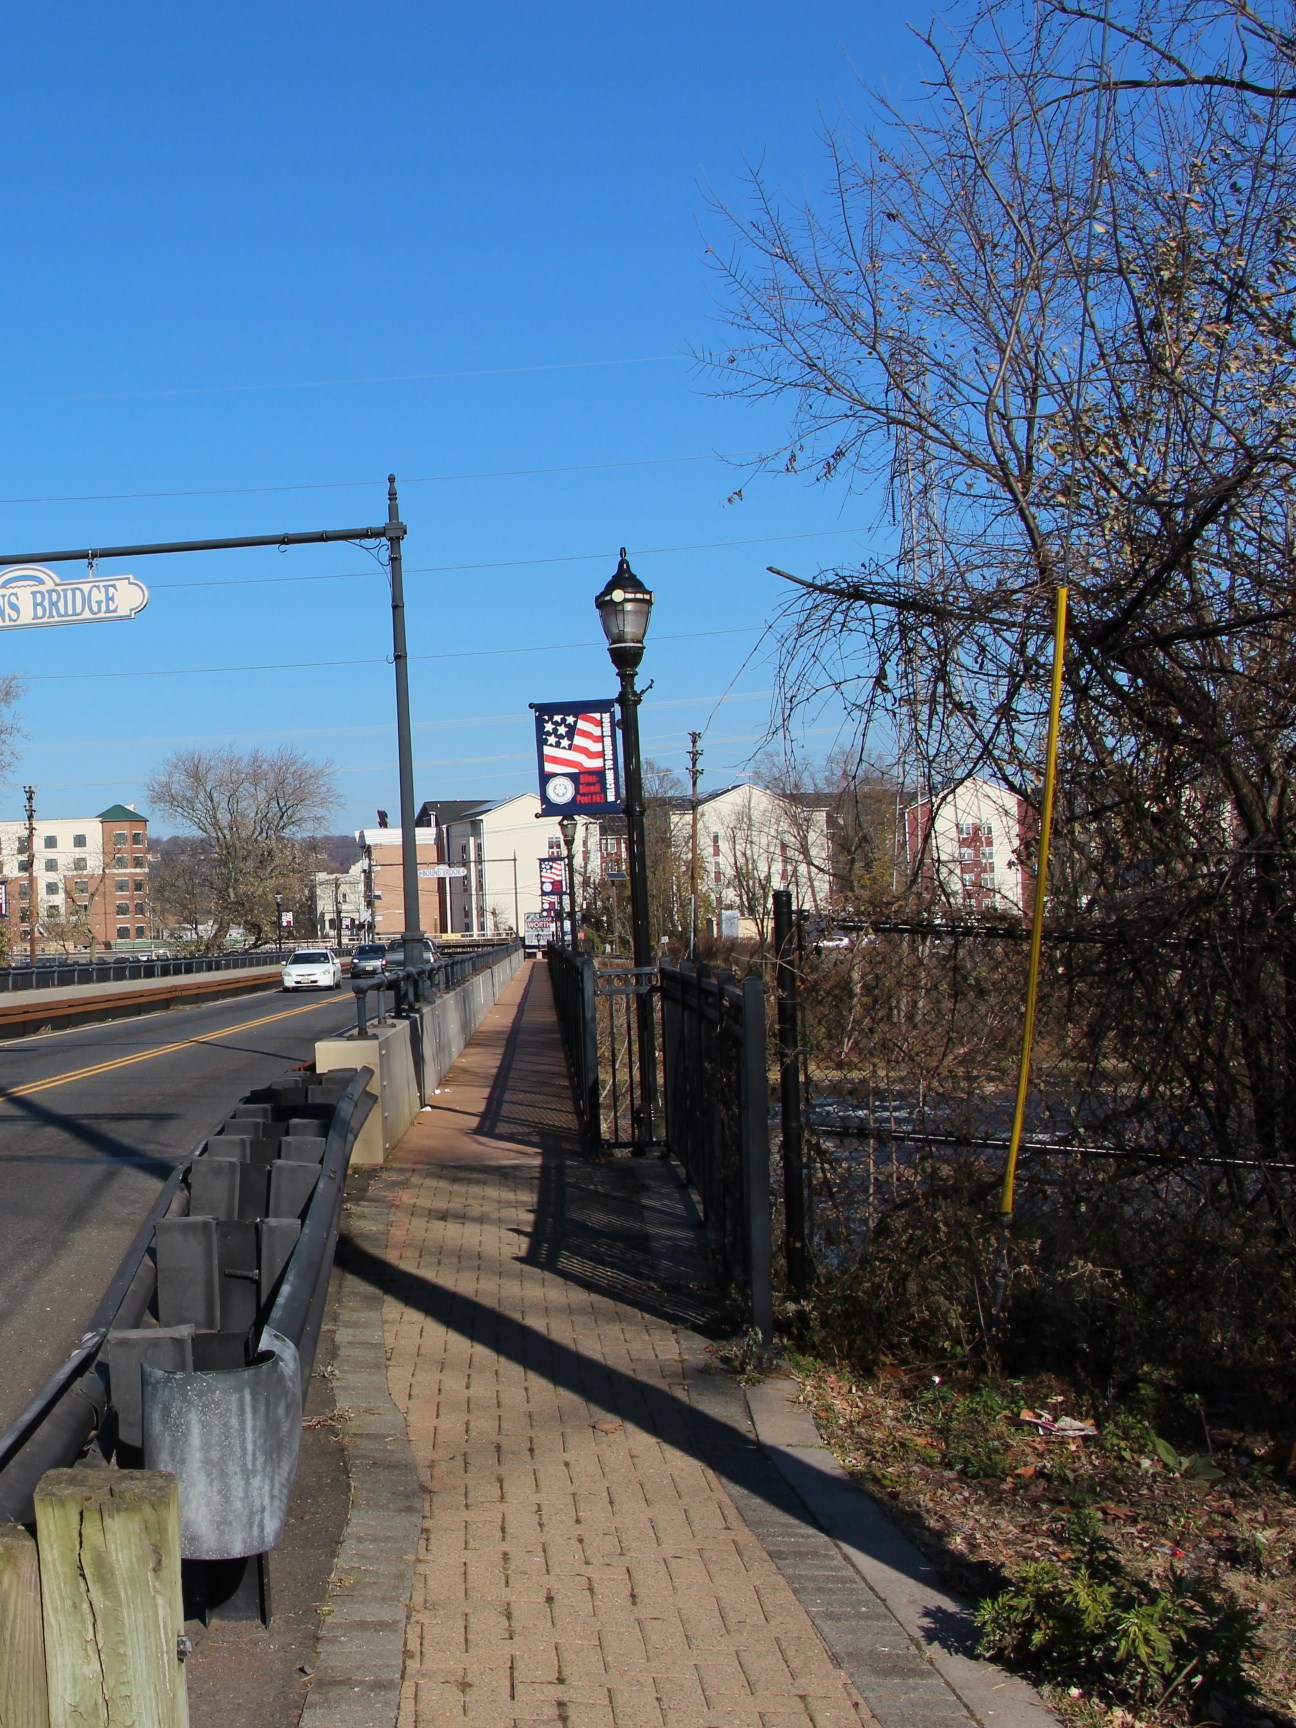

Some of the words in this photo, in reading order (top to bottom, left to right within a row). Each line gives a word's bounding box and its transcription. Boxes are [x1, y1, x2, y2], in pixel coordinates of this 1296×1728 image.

[30, 583, 119, 620] BRIDGE
[602, 713, 611, 736] BROOK
[604, 737, 613, 759] BOUND
[605, 760, 613, 769] TO
[605, 769, 615, 802] WELCOME
